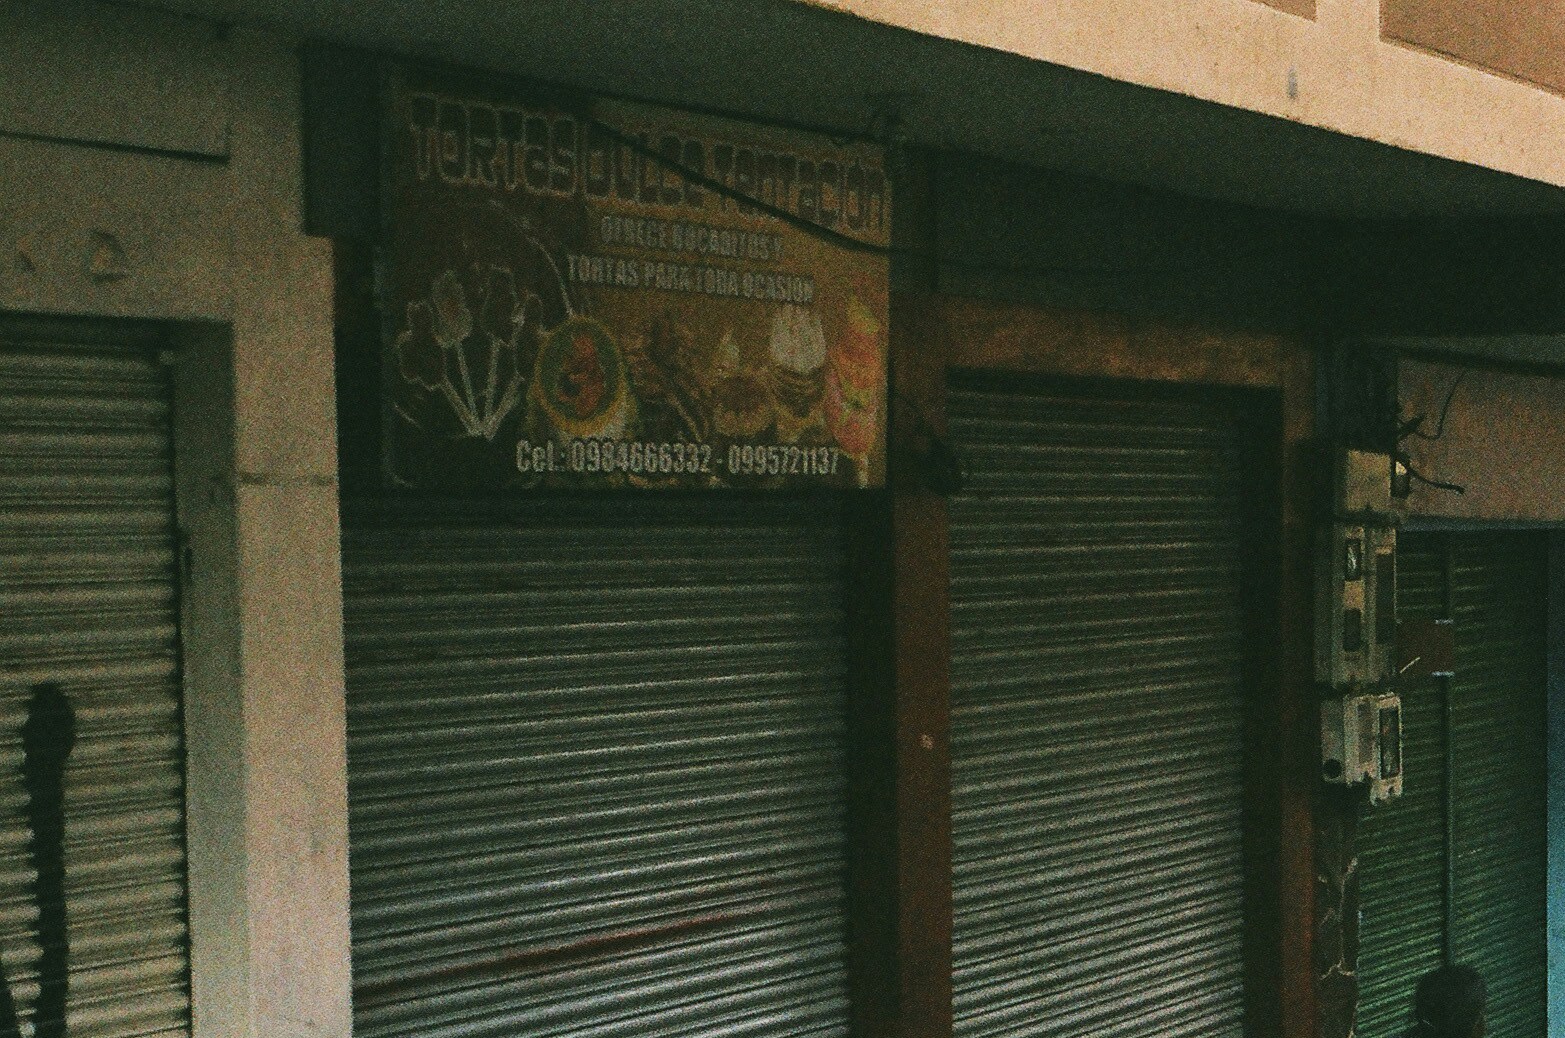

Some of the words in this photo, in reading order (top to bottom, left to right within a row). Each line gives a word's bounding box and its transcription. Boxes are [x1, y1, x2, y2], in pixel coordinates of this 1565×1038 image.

[567, 253, 640, 288] TORTAS
[643, 260, 690, 292] PARA
[694, 266, 740, 297] TODA
[569, 440, 712, 474] 0984666332
[727, 443, 840, 475] 0995721137
